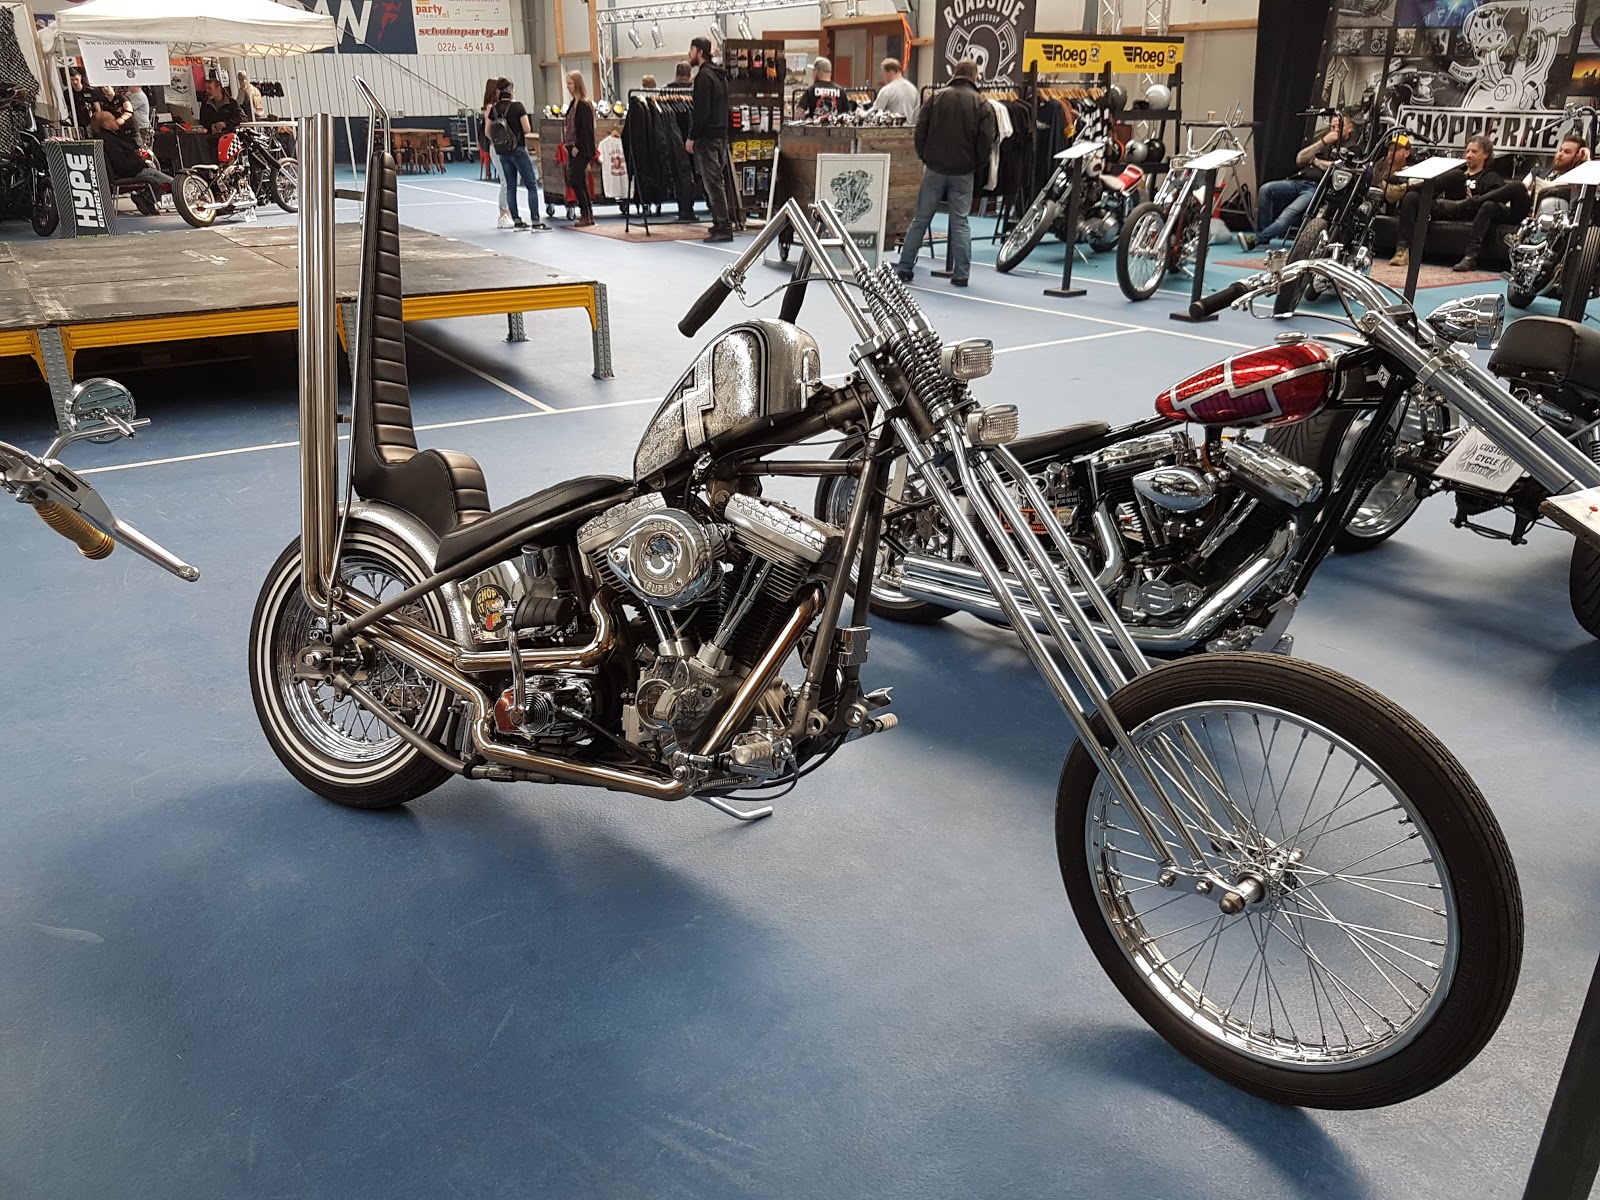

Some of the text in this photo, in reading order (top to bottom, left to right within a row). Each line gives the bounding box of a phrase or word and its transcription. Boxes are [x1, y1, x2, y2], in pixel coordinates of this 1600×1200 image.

[415, 5, 442, 15] party
[943, 0, 1025, 29] ROADSIDE
[963, 13, 1000, 26] REPAIRSHOP
[418, 27, 509, 37] schuimparty.nl
[437, 42, 457, 52] 0226
[464, 42, 473, 52] 45
[475, 42, 483, 52] 41
[485, 42, 495, 52] 43
[1053, 44, 1087, 66] Roeg
[1133, 47, 1165, 67] Roeg
[104, 58, 153, 67] HOOGVLIET
[814, 88, 840, 97] DEATH
[65, 153, 99, 228] HYPE
[87, 155, 105, 228] ENERGY DRINKS
[1475, 453, 1500, 466] CYCLE
[1468, 464, 1489, 476] CREW
[646, 581, 675, 593] SUPER
[477, 588, 497, 604] CHOP
